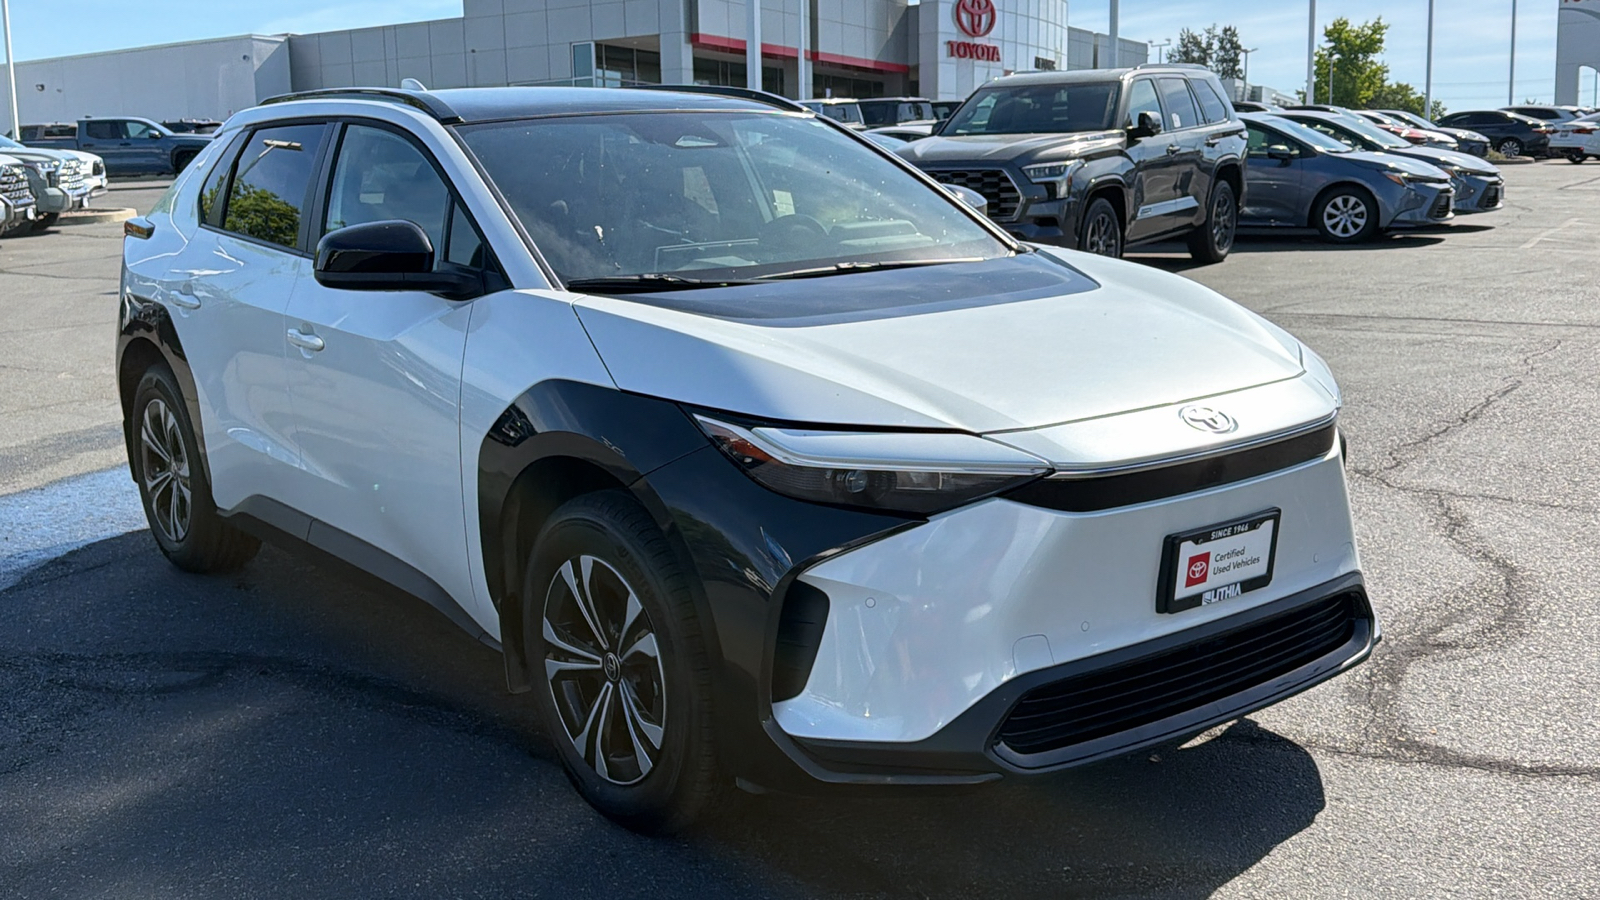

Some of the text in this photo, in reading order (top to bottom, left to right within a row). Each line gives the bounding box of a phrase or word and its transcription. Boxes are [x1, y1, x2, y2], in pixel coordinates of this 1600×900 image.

[946, 40, 1001, 62] TOYOTA
[1210, 527, 1232, 540] SINCE
[1214, 546, 1246, 562] Certified
[1213, 556, 1260, 575] Used Vehicles
[1211, 582, 1242, 602] LITHIA
